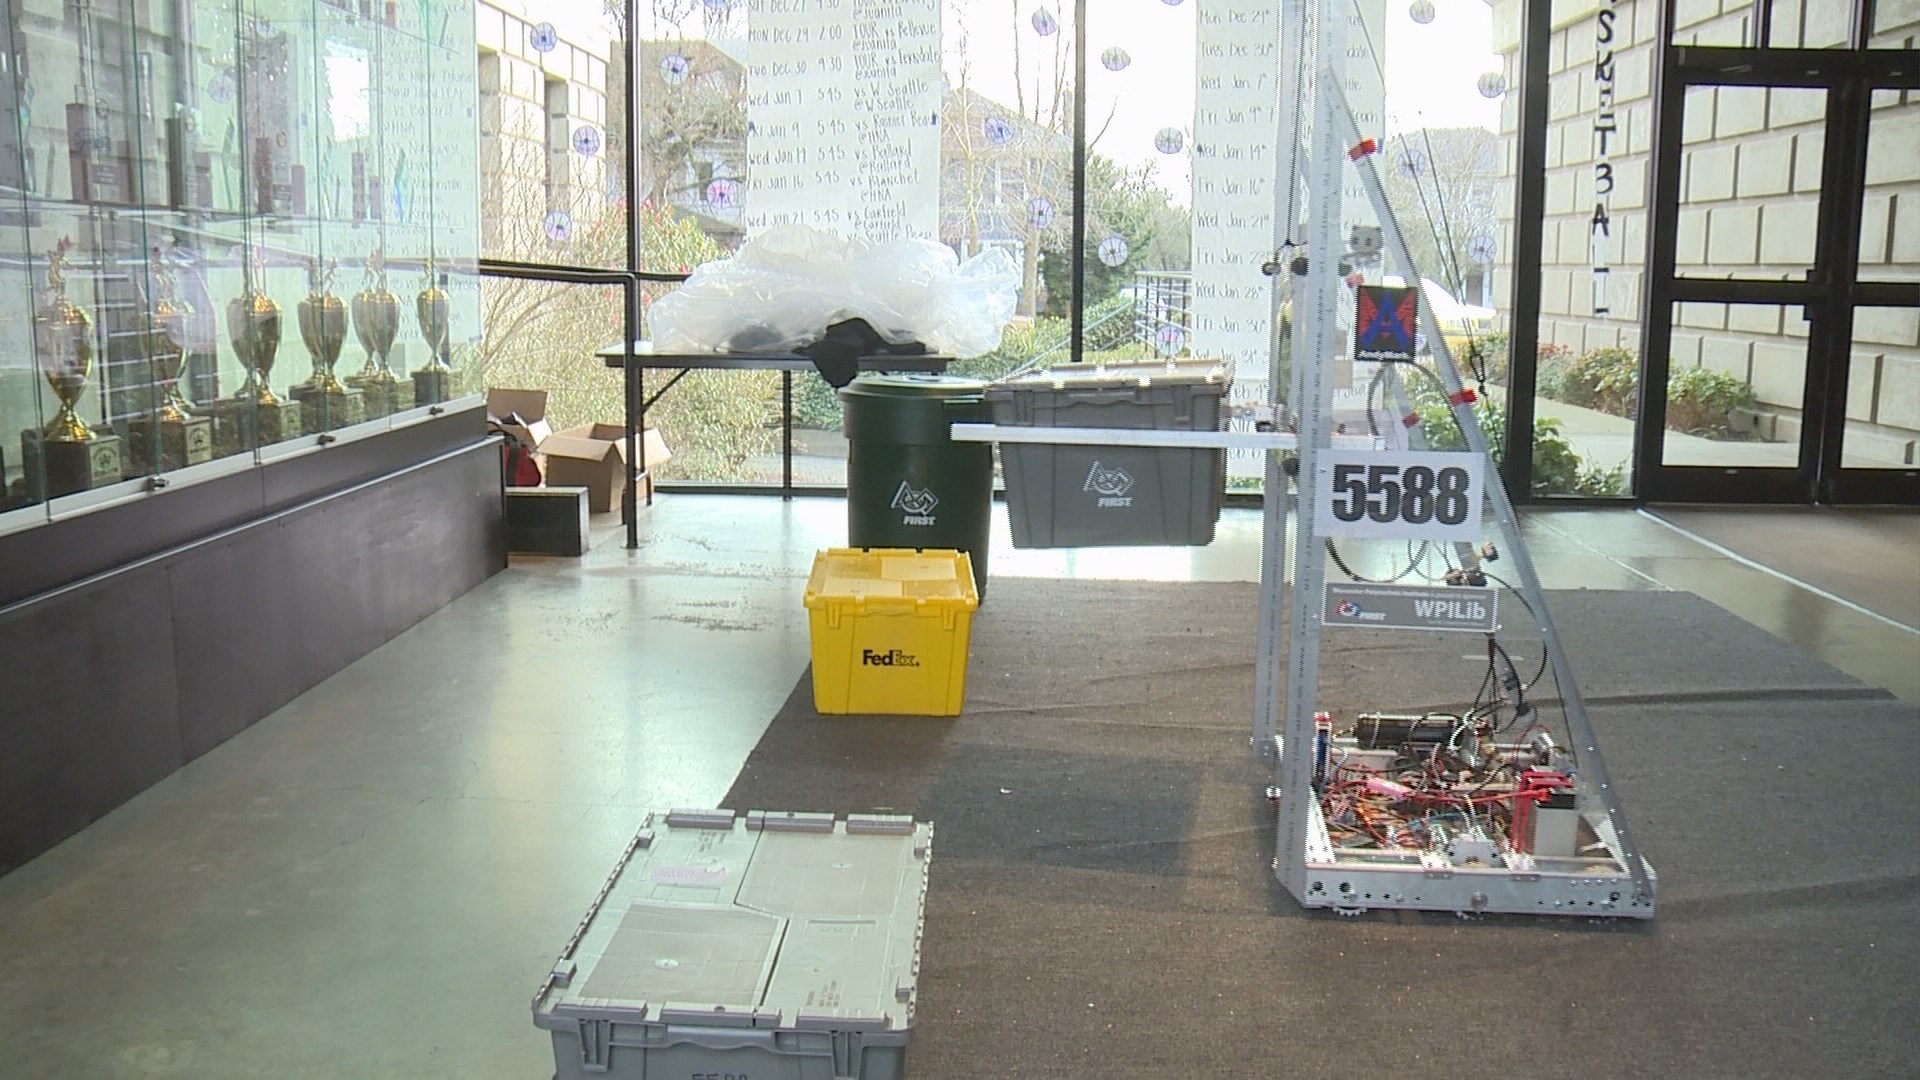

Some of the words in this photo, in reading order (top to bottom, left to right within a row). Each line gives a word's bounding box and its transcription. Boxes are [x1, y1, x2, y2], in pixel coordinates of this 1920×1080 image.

[1097, 496, 1134, 508] FIRST
[1332, 464, 1471, 525] 5588
[903, 514, 937, 526] FIRST
[1413, 598, 1487, 620] WPILib
[862, 649, 920, 667] FedEx
